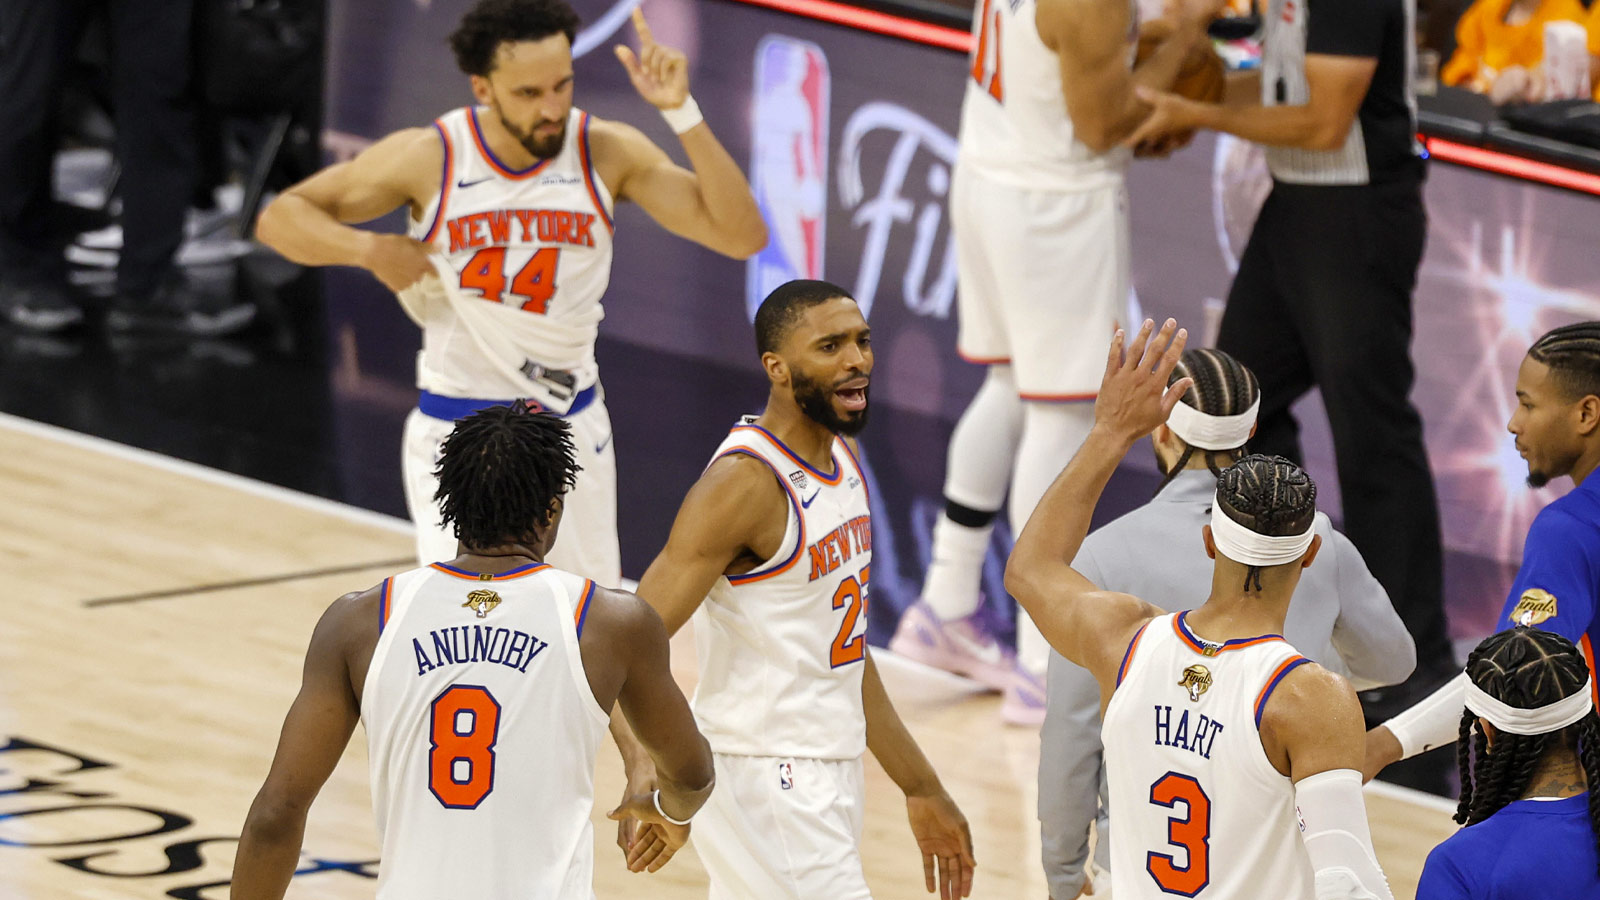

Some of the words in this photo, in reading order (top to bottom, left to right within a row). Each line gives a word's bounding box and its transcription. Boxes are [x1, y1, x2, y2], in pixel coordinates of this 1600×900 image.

[459, 247, 561, 315] 44
[808, 521, 851, 583] NEW
[461, 592, 500, 607] Finals
[412, 625, 548, 676] ANUNOBY
[1178, 668, 1212, 686] Finals
[428, 684, 501, 810] 8
[1155, 705, 1224, 760] HART
[1146, 771, 1211, 899] 3
